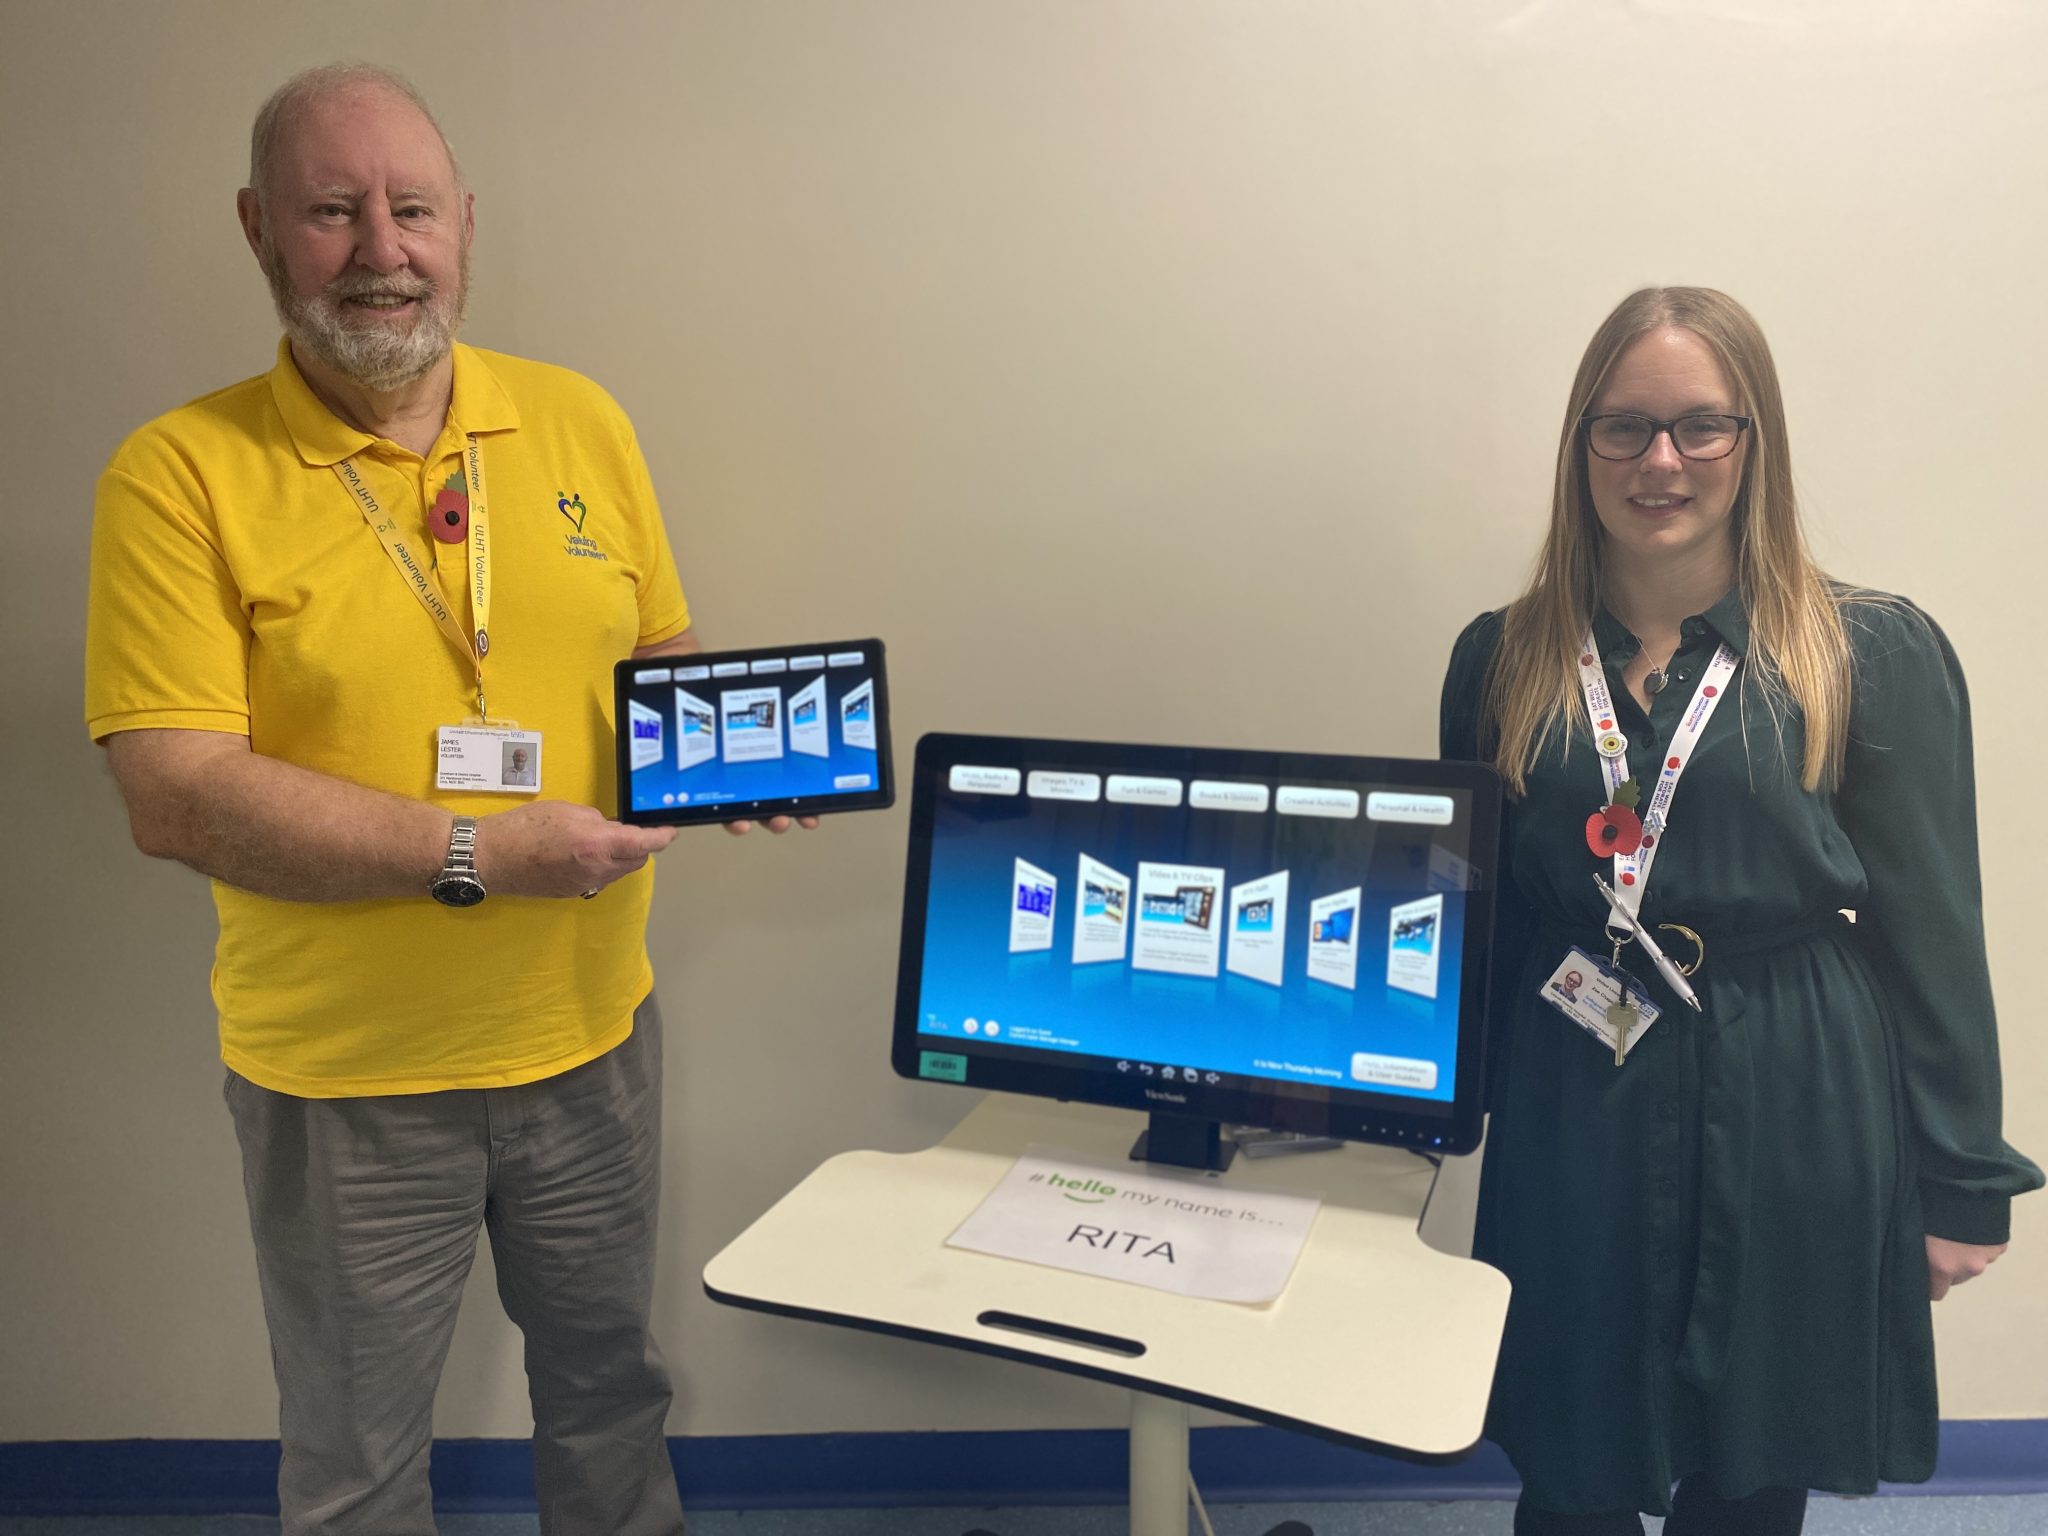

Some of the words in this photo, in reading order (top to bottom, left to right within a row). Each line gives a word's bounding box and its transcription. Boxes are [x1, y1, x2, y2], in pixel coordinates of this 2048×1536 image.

[469, 446, 480, 493] Volunteer
[356, 487, 379, 513] ULHT
[474, 525, 485, 553] ULHT
[565, 534, 597, 551] Valuing
[394, 543, 427, 593] Volunteer
[475, 553, 486, 607] Volunteer
[424, 592, 447, 621] ULHT
[1587, 688, 1595, 701] WELL
[1593, 686, 1603, 709] HYDRATE
[1596, 677, 1606, 697] HEALTH
[1656, 780, 1668, 808] HYDRATE
[1661, 793, 1669, 810] WELL
[1047, 1173, 1118, 1197] hello
[1121, 1187, 1160, 1206] my
[1163, 1195, 1234, 1219] name
[1067, 1224, 1176, 1264] RITA
